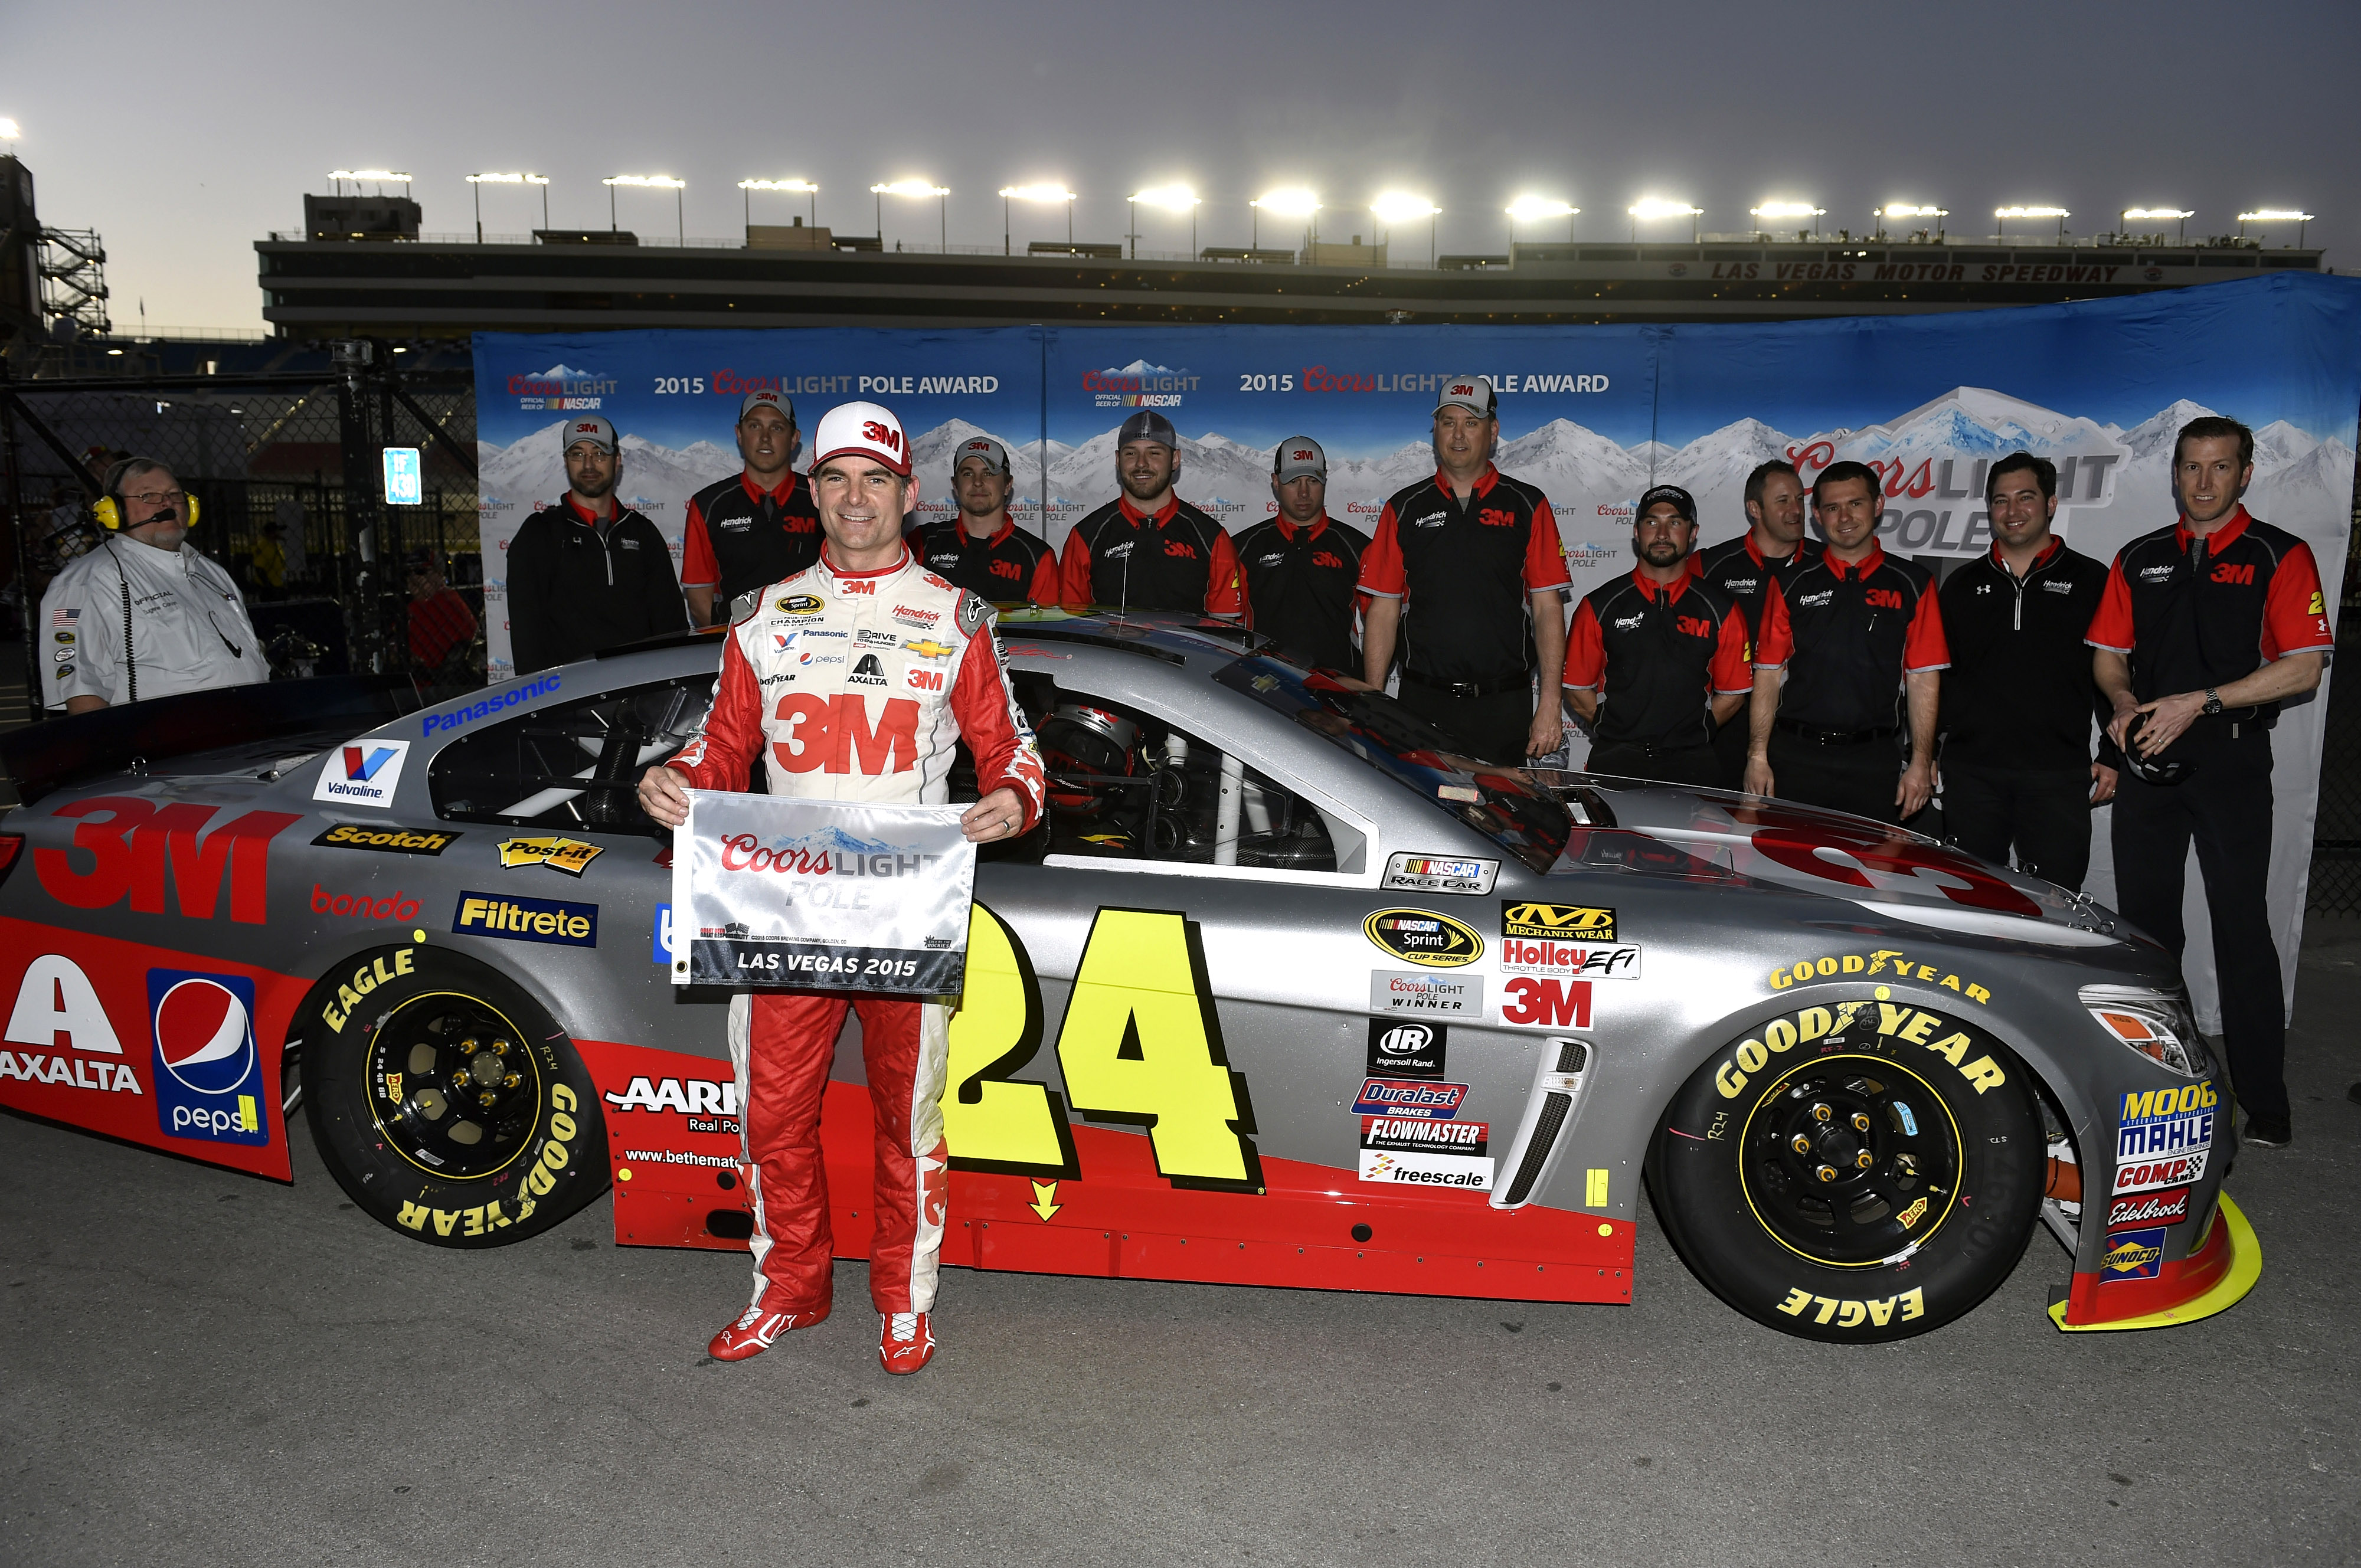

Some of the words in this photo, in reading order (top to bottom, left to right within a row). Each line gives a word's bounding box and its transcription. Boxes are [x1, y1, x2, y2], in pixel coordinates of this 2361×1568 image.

[1711, 263, 1759, 279] LAS
[1775, 263, 1856, 281] VEGAS
[1874, 264, 1964, 281] MOTOR
[1982, 265, 2120, 283] SPEEDWAY
[655, 377, 704, 394] 2015
[859, 377, 913, 394] POLE
[918, 376, 998, 394] AWARD
[1240, 374, 1293, 391] 2015
[1523, 374, 1610, 392] AWARD
[1450, 385, 1474, 397] 3M
[563, 398, 601, 410] NASCAR
[756, 392, 778, 402] 3M
[1140, 395, 1181, 407] NASCAR
[577, 423, 598, 434] 3M
[862, 420, 900, 452] 3M
[968, 441, 990, 452] 3M
[1293, 450, 1313, 461] 3M
[393, 454, 408, 473] IF
[391, 473, 416, 498] 430
[721, 516, 753, 528] Hendrick
[783, 516, 815, 533] 3M
[1416, 511, 1447, 527] Hendrick
[1479, 508, 1515, 527] 3M
[1881, 509, 1990, 550] POLE
[1163, 539, 1197, 559] 3M
[1312, 551, 1343, 568] 3M
[1572, 559, 1597, 567] POLE
[989, 558, 1022, 581] 3M
[2210, 562, 2255, 585] 3M
[842, 581, 876, 595] 3M
[923, 573, 954, 592] 3M
[1725, 579, 1757, 589] Hendrick
[134, 591, 173, 605] OFFICIAL
[1865, 588, 1902, 609] 3M
[771, 617, 824, 625] CHAMPION
[892, 605, 941, 621] Hendrick
[803, 630, 848, 638] Panasonic
[1676, 615, 1711, 639] 3M
[816, 656, 845, 664] pepsi
[847, 676, 888, 686] AXALTA
[907, 669, 943, 691] 3M
[423, 675, 561, 738] Panasonic
[773, 692, 921, 775] 3M
[328, 782, 382, 798] Valvoline
[326, 826, 447, 850] Scotch
[505, 842, 593, 859] Post-it
[33, 796, 305, 925] 3M
[1427, 861, 1477, 878] NASCAR
[1391, 876, 1438, 888] RACE
[1443, 879, 1483, 891] CAR
[310, 883, 420, 921] bondo
[786, 880, 874, 911] POLE
[460, 898, 590, 938] Filtrete
[1397, 919, 1437, 931] NASCAR
[1403, 932, 1444, 947] Sprint
[1506, 924, 1575, 937] MECHANIX
[1577, 928, 1613, 941] WEAR
[737, 952, 780, 971] LAS
[787, 955, 858, 974] VEGAS
[865, 958, 917, 977] 2015
[1407, 953, 1432, 962] CUP
[1433, 955, 1469, 963] SERIES
[1503, 940, 1587, 974] Holley
[322, 948, 415, 1033] EAGLE
[1392, 999, 1462, 1010] WINNER
[1502, 977, 1592, 1027] 3M
[940, 901, 1263, 1194] 24
[1389, 1027, 1423, 1050] IR
[377, 1058, 384, 1069] 24
[1376, 1057, 1411, 1068] Ingersoll
[1412, 1059, 1433, 1068] Rand
[0, 1051, 143, 1095] AXALTA
[377, 1072, 384, 1083] 48
[390, 1077, 400, 1099] AERO
[1363, 1084, 1459, 1105] Duralast
[2122, 1080, 2218, 1121] MOOG
[1387, 1107, 1431, 1117] BRAKES
[2127, 1117, 2162, 1126] STEERING
[2176, 1107, 2213, 1119] SUSPENSION
[689, 1119, 718, 1131] Real
[1366, 1119, 1480, 1144] FLOWMASTER
[2119, 1114, 2212, 1157] MAHLE
[2167, 1147, 2187, 1155] ENGINE
[2187, 1142, 2210, 1152] BEARINGS
[1394, 1168, 1483, 1186] freescale
[2117, 1159, 2187, 1188] COMP
[2164, 1172, 2196, 1185] CAMS
[1904, 1202, 1924, 1225] AERO
[2108, 1194, 2186, 1226] Edelbrock
[2101, 1247, 2159, 1268] SUNOCO
[1776, 1286, 1925, 1327] EAGLE
